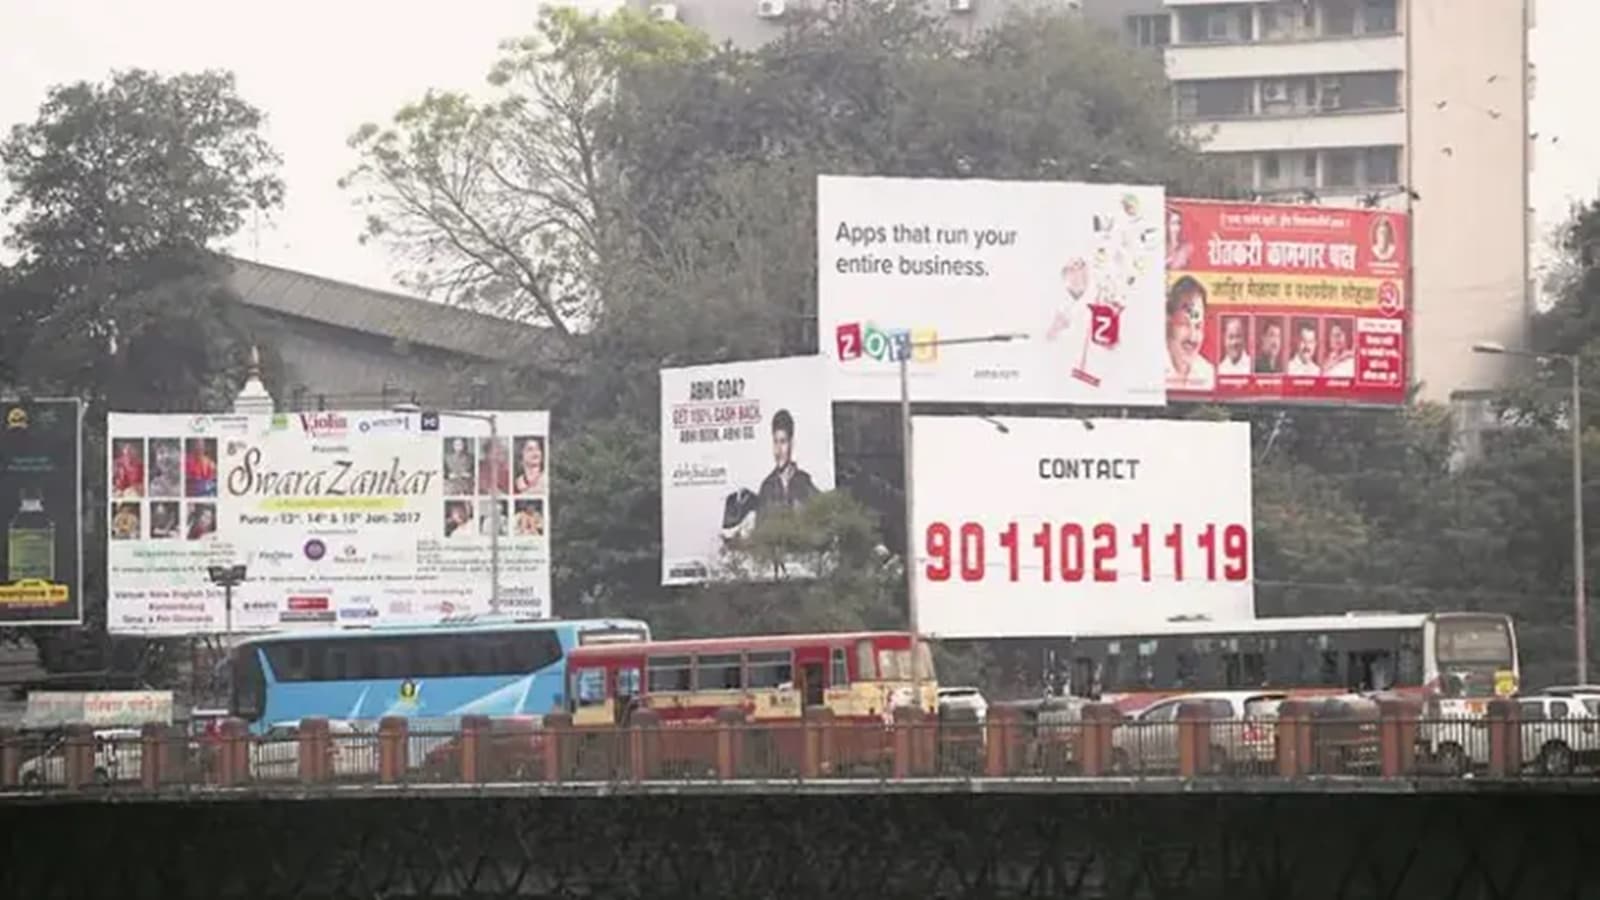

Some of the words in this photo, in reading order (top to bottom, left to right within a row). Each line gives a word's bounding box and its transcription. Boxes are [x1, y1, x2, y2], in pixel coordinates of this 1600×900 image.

[836, 222, 887, 248] Apps
[893, 224, 931, 245] that
[936, 228, 968, 245] run
[973, 228, 1017, 250] your
[836, 256, 893, 274] entire
[899, 255, 990, 277] business.
[690, 381, 714, 401] ABHI
[717, 377, 746, 400] GOA?
[672, 408, 689, 424] GET
[714, 405, 738, 422] CASH
[325, 456, 438, 496] Zankar
[1038, 458, 1140, 480] CONTACT
[392, 511, 421, 524] 2017
[926, 522, 1248, 583] 9011021119
